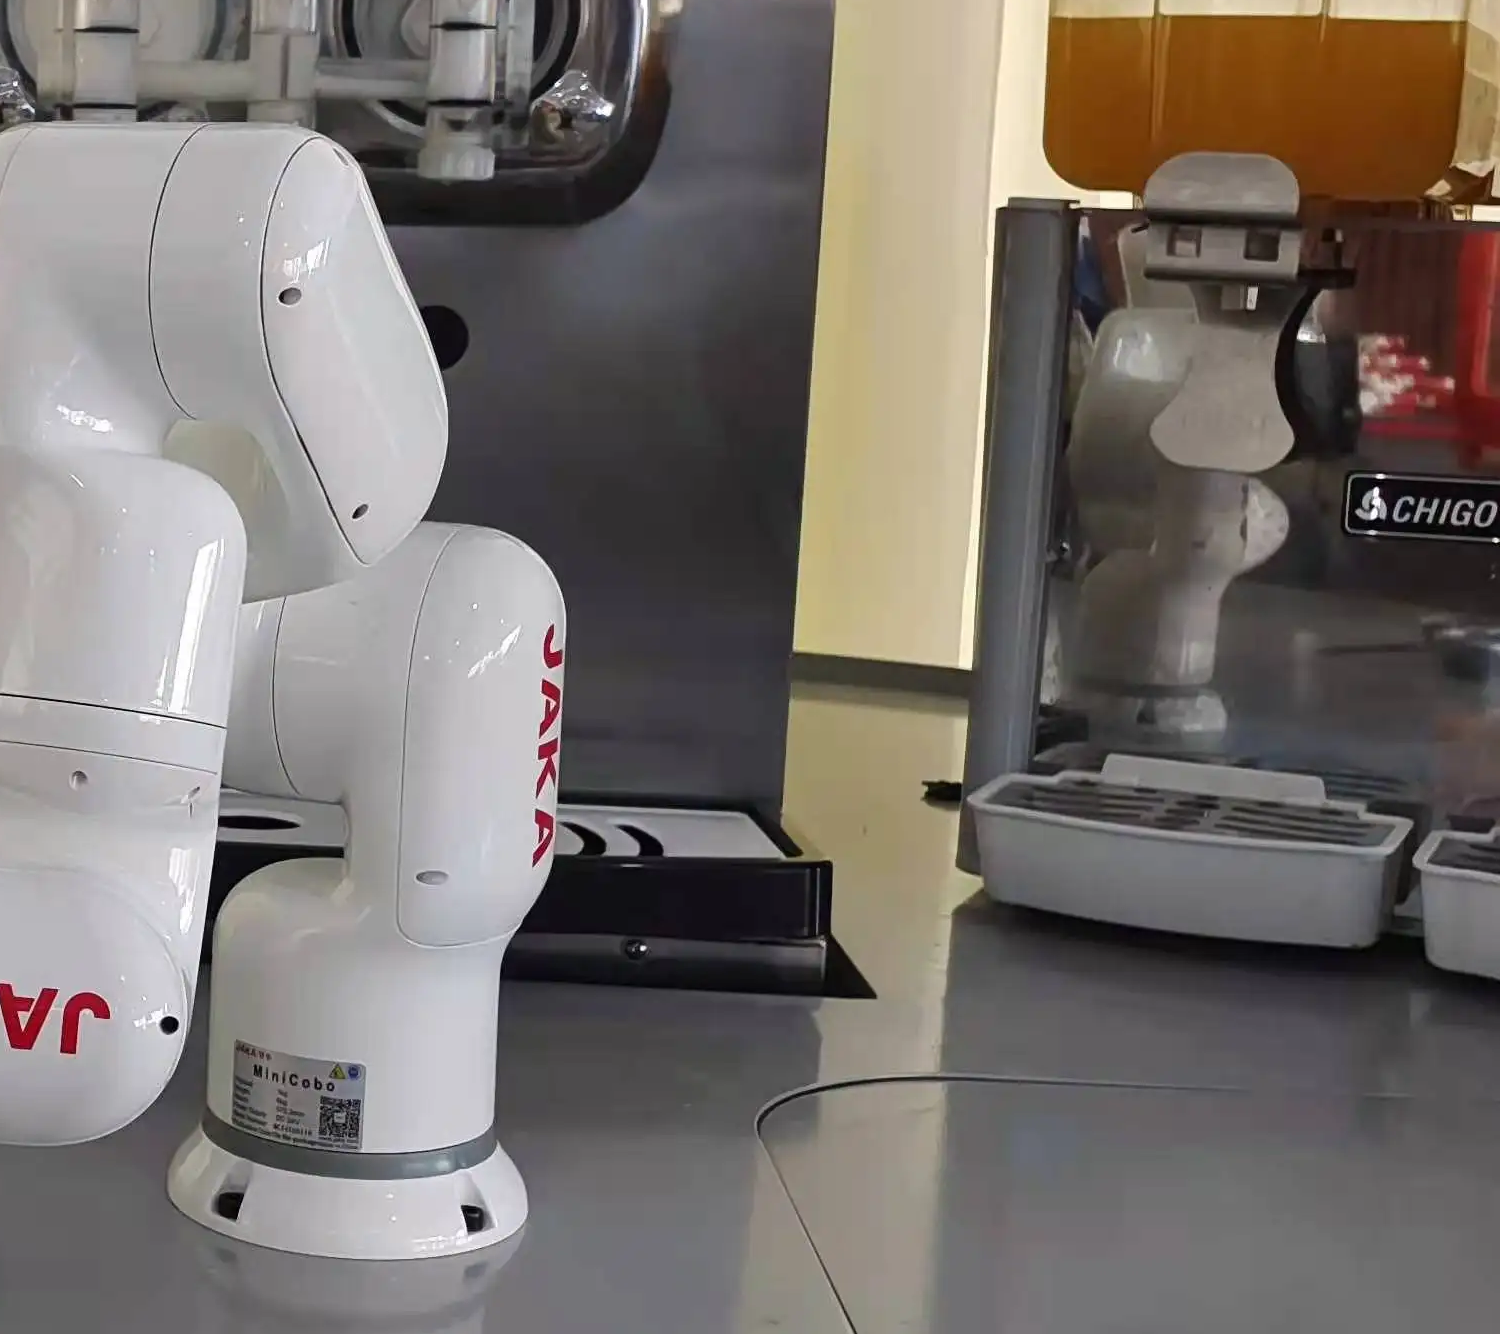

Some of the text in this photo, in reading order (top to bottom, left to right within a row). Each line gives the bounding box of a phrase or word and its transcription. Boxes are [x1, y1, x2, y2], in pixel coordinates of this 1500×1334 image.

[1392, 495, 1498, 528] CHIGO
[532, 624, 564, 867] JAKA
[253, 1064, 336, 1092] MiniCobo
